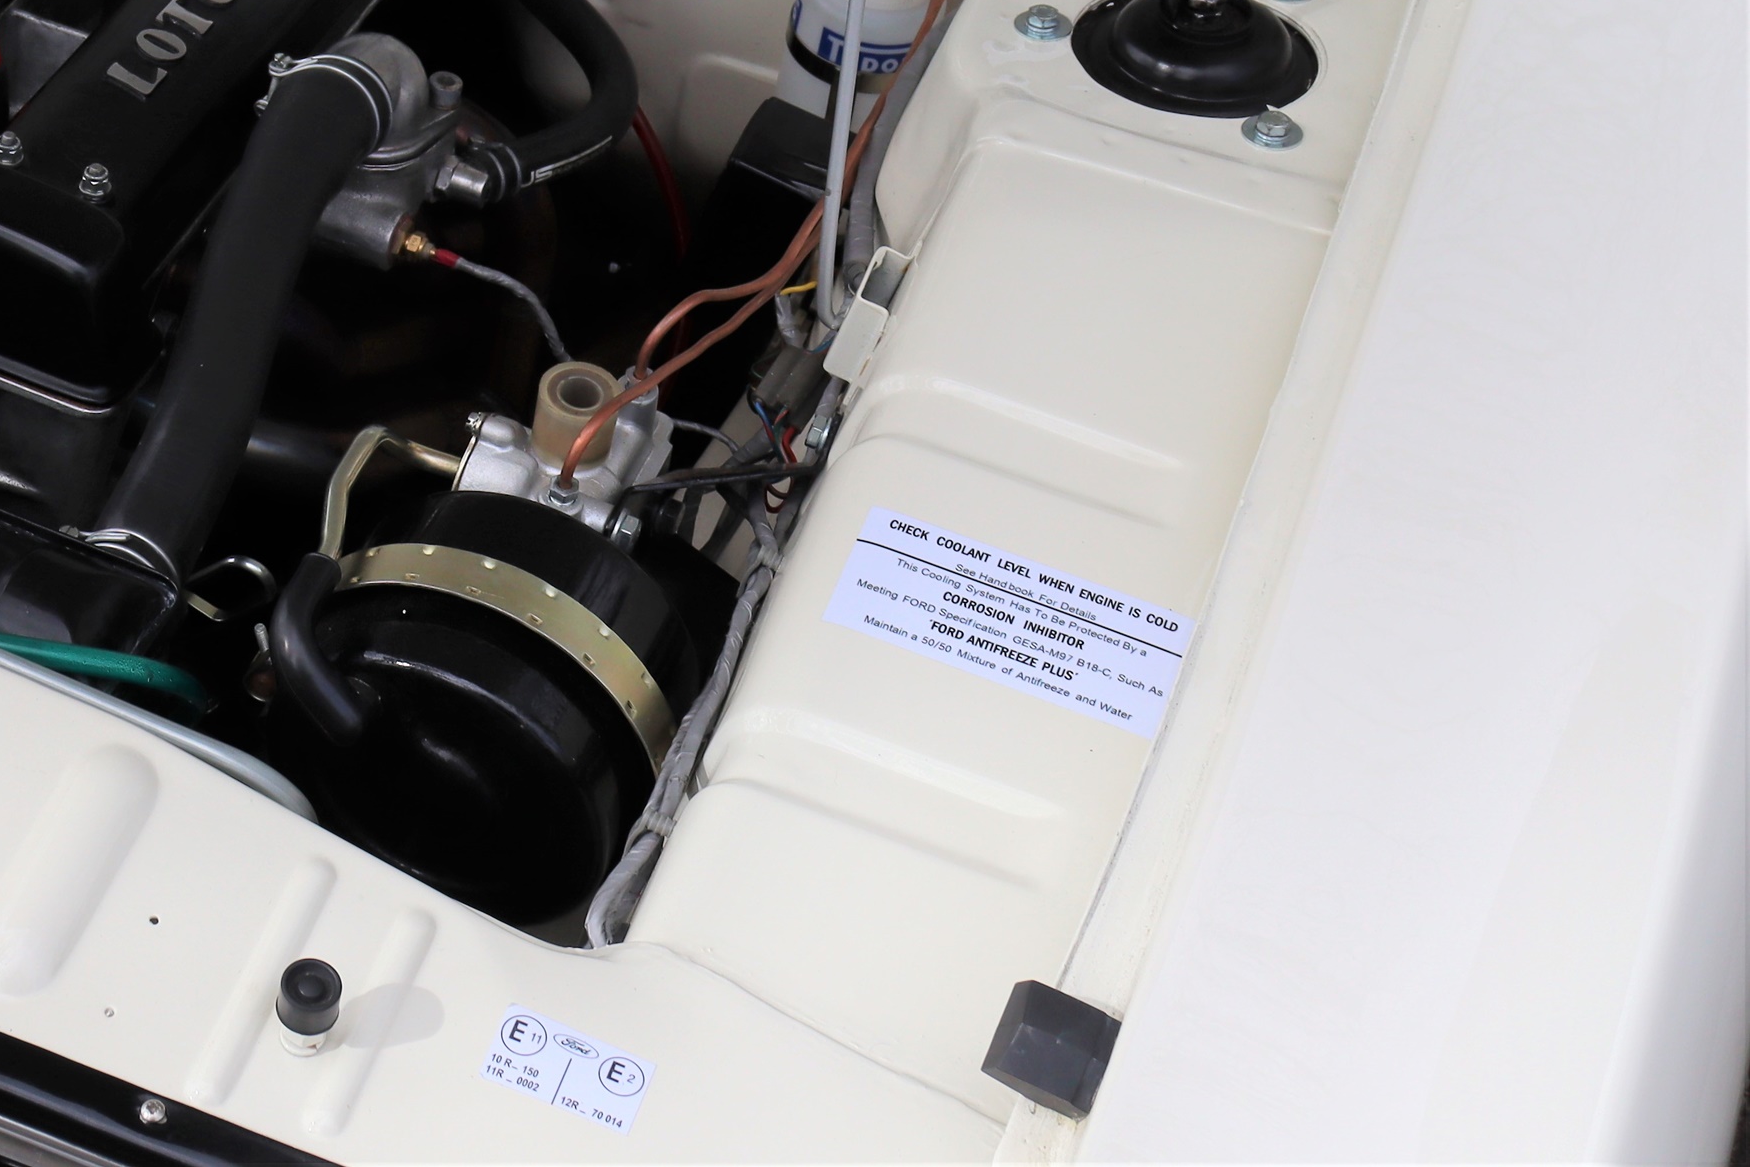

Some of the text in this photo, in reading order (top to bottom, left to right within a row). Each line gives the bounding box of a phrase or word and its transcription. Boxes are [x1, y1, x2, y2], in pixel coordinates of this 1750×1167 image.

[889, 519, 1179, 633] CHECK COOLANT LEVEL WHEN ENGINE IS COLD
[955, 563, 977, 578] See
[1038, 593, 1058, 607] For
[1061, 600, 1097, 621] Details
[896, 558, 1148, 657] This Cooling System Has To Be Protected By a
[942, 590, 1085, 650] CORROSION INHIBITOR
[856, 578, 1164, 697] Meeting FORD Specification GESA-M97 B18-C, Such As
[966, 635, 1038, 668] ANTIFREEZE
[863, 614, 1133, 721] Maintain a 50/50 Mixture of Antifreeze and Water
[508, 1019, 543, 1044] E 11
[561, 1037, 591, 1056] Ford
[485, 1065, 503, 1078] 11R
[516, 1076, 540, 1092] 0002
[491, 1053, 502, 1063] 10
[522, 1065, 539, 1078] 150
[606, 1060, 636, 1084] E 2
[591, 1108, 604, 1120] 70
[605, 1115, 623, 1128] 014
